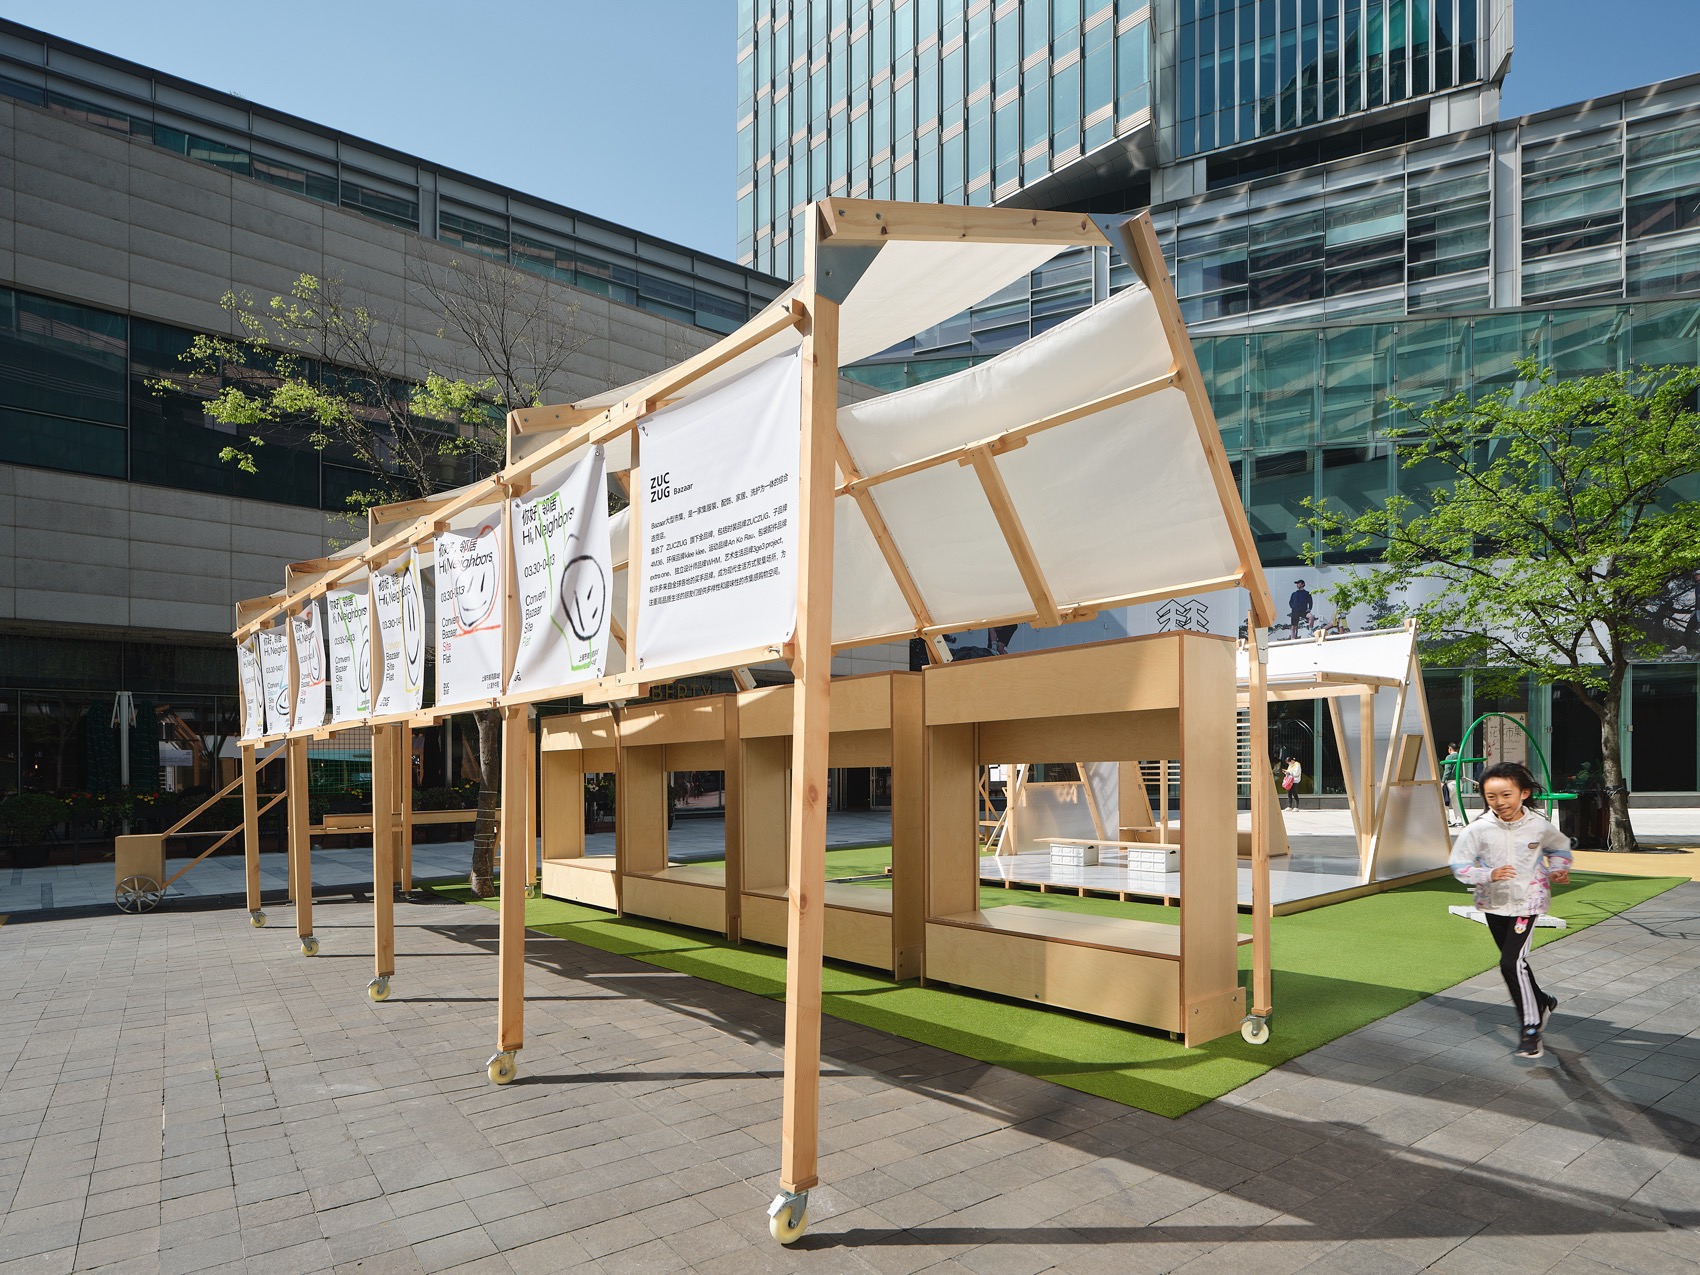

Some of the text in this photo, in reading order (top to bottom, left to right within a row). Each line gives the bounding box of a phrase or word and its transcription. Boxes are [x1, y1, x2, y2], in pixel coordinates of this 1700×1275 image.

[650, 472, 670, 490] ZUC
[650, 483, 694, 503] ZUG Bazaar
[522, 506, 575, 546] Hi, Neighbors
[446, 551, 494, 572] Neighbors
[378, 592, 390, 606] Hi,
[525, 586, 547, 607] Conveni
[337, 606, 368, 623] Neighbors
[525, 605, 543, 620] Bazaar
[442, 628, 458, 640] Bazaar
[524, 621, 534, 635] Site
[442, 641, 452, 652] Site
[385, 651, 401, 662] Bazaar
[443, 653, 452, 664] Flat
[386, 662, 395, 672] Site
[385, 672, 395, 682] Flat
[1489, 723, 1522, 738] 花市集
